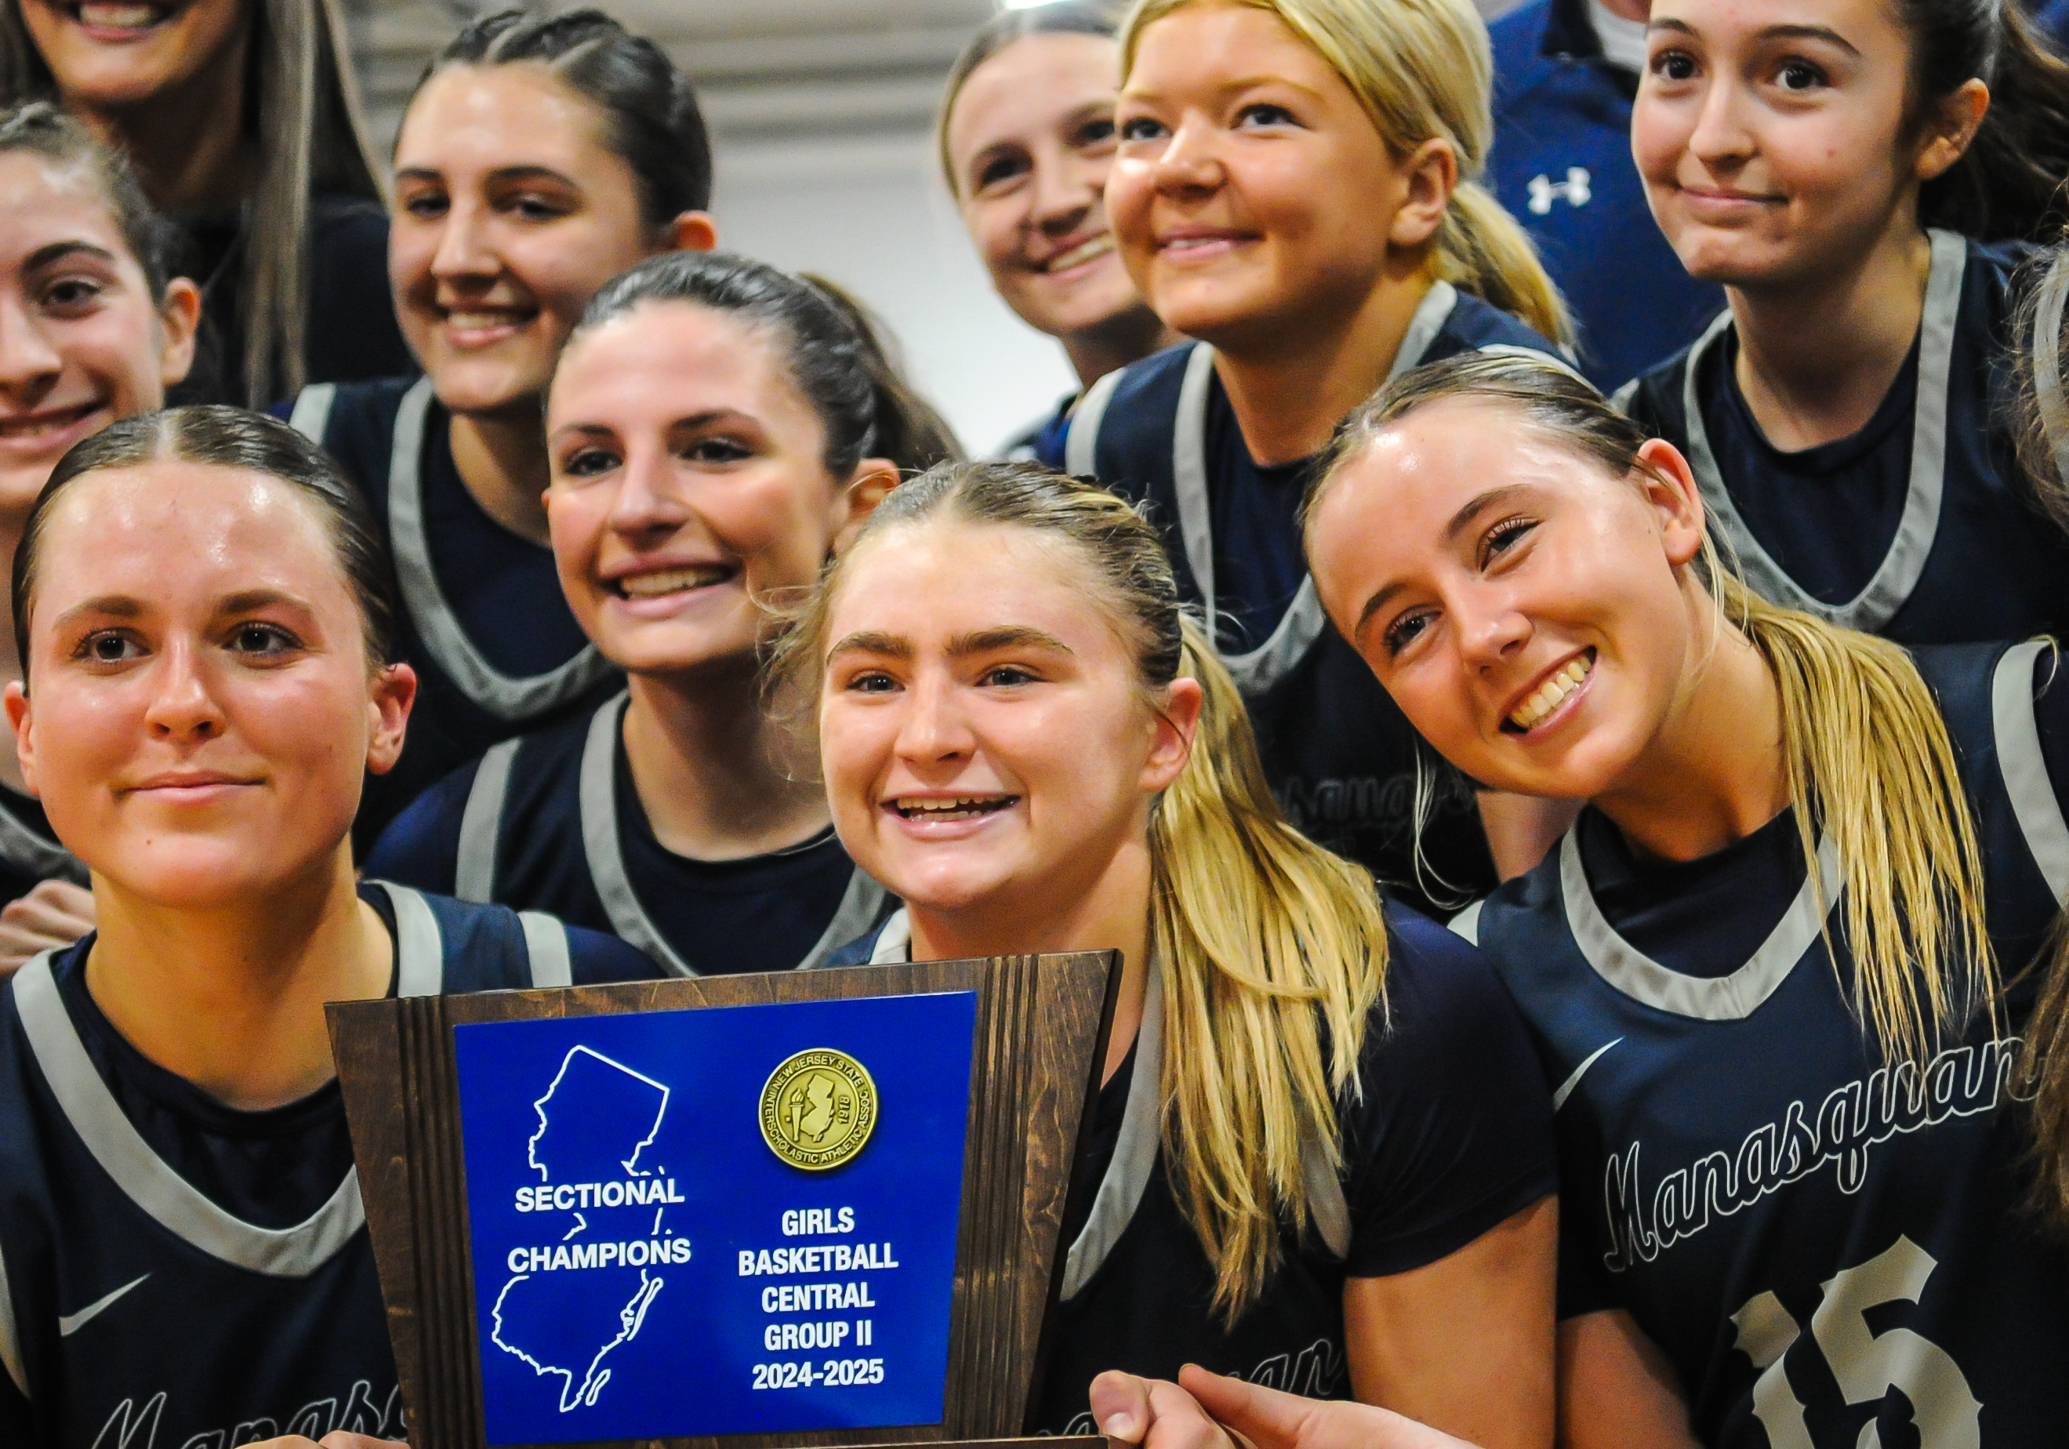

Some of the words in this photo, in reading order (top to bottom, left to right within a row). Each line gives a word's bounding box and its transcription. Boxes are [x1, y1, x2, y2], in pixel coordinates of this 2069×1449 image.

[773, 1065, 793, 1090] NEW
[794, 1055, 836, 1071] JERSEY
[836, 1060, 864, 1087] STATE
[765, 1090, 819, 1163] INTERSCHOLASTIC
[820, 1128, 863, 1163] ATHLETIC
[838, 1096, 850, 1124] 1918
[1603, 1036, 2047, 1273] Manasquan
[515, 1178, 686, 1213] SECTIONAL
[782, 1206, 855, 1237] GIRLS
[507, 1238, 692, 1273] CHAMPIONS
[739, 1243, 899, 1277] BASKETBALL
[762, 1282, 876, 1313] CENTRAL
[765, 1322, 850, 1351] GROUP
[857, 1320, 872, 1346] II
[1729, 1234, 1984, 1449] 15
[753, 1358, 885, 1390] 2024-2025
